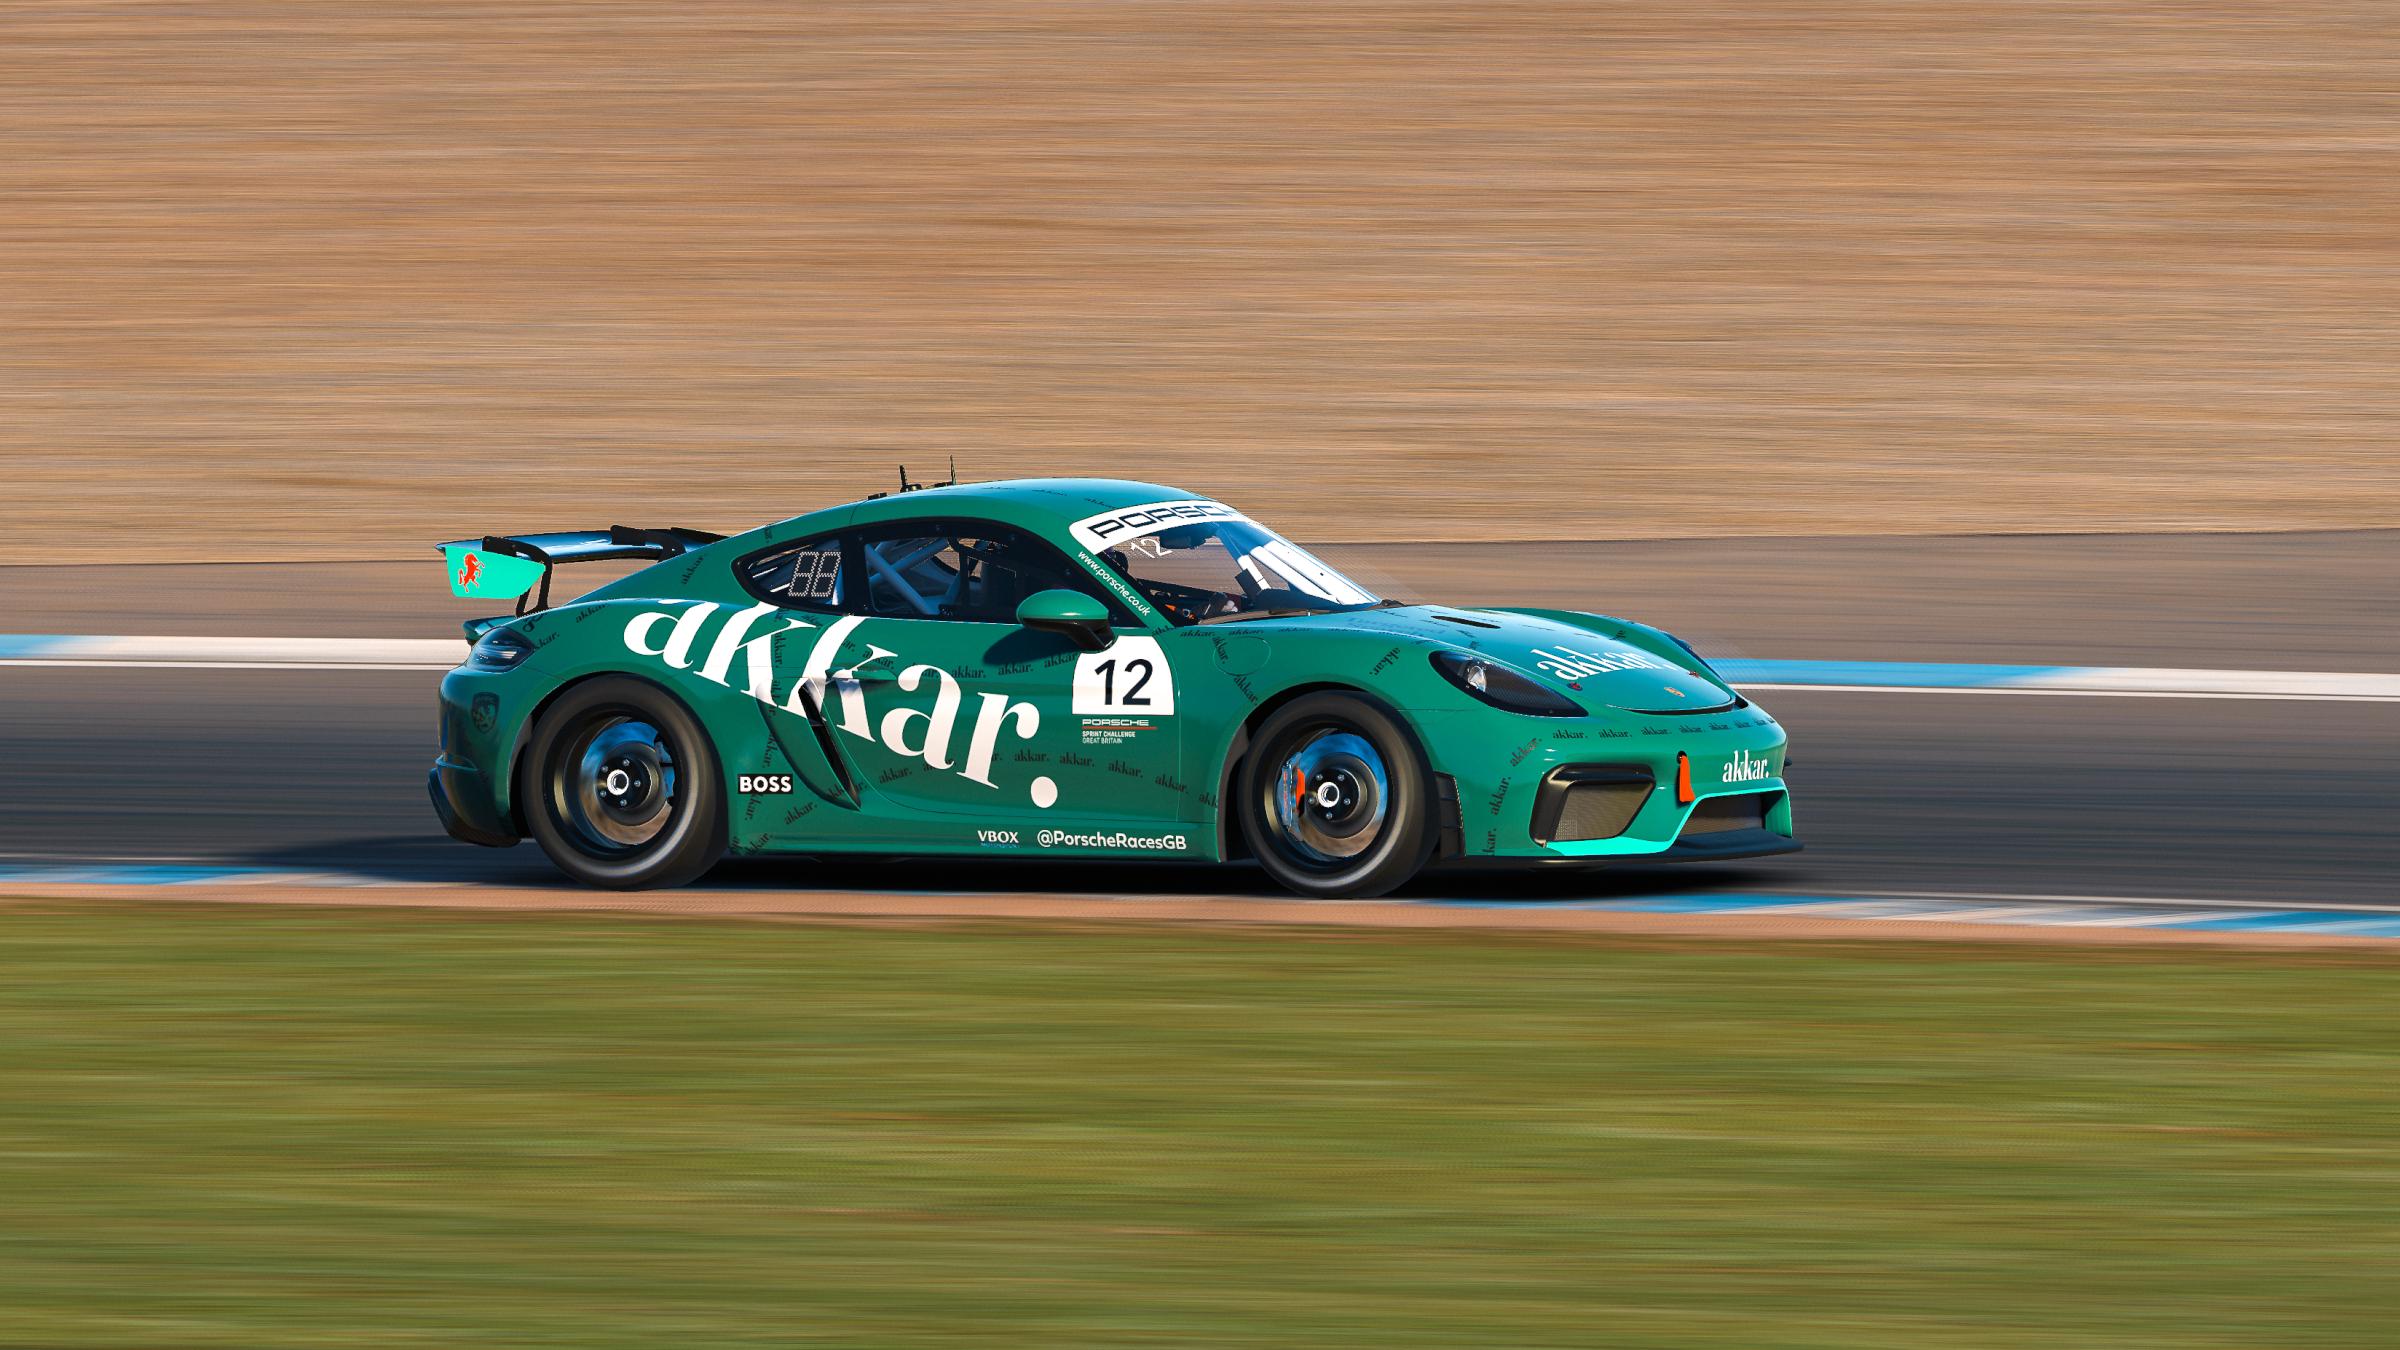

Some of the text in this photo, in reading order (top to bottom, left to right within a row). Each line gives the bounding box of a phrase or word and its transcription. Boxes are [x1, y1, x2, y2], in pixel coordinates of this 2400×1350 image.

[1087, 505, 1232, 539] PORSC
[1130, 538, 1173, 558] 12
[1077, 551, 1150, 617] www.porsche.co.uk
[1094, 658, 1153, 706] 12
[622, 598, 1058, 808] akkar.
[1081, 718, 1150, 727] PORSCHE
[1552, 729, 1588, 739] akkar.
[1598, 728, 1633, 739] akkar.
[1082, 730, 1137, 739] SPRINT CHALLENGE
[1101, 737, 1123, 745] BRITAIN
[1509, 737, 1543, 768] akkar.
[880, 766, 913, 784] akkar.
[1014, 749, 1050, 762] akkar.
[1059, 751, 1096, 768] akkar.
[1108, 759, 1144, 779] akkar.
[1722, 749, 1769, 783] akkar.
[739, 775, 791, 793] BOSS
[1488, 776, 1512, 816] akkar.
[784, 802, 819, 825] akkar.
[977, 830, 1019, 844] VBOX
[1037, 829, 1187, 851] @PorscheRacesGB
